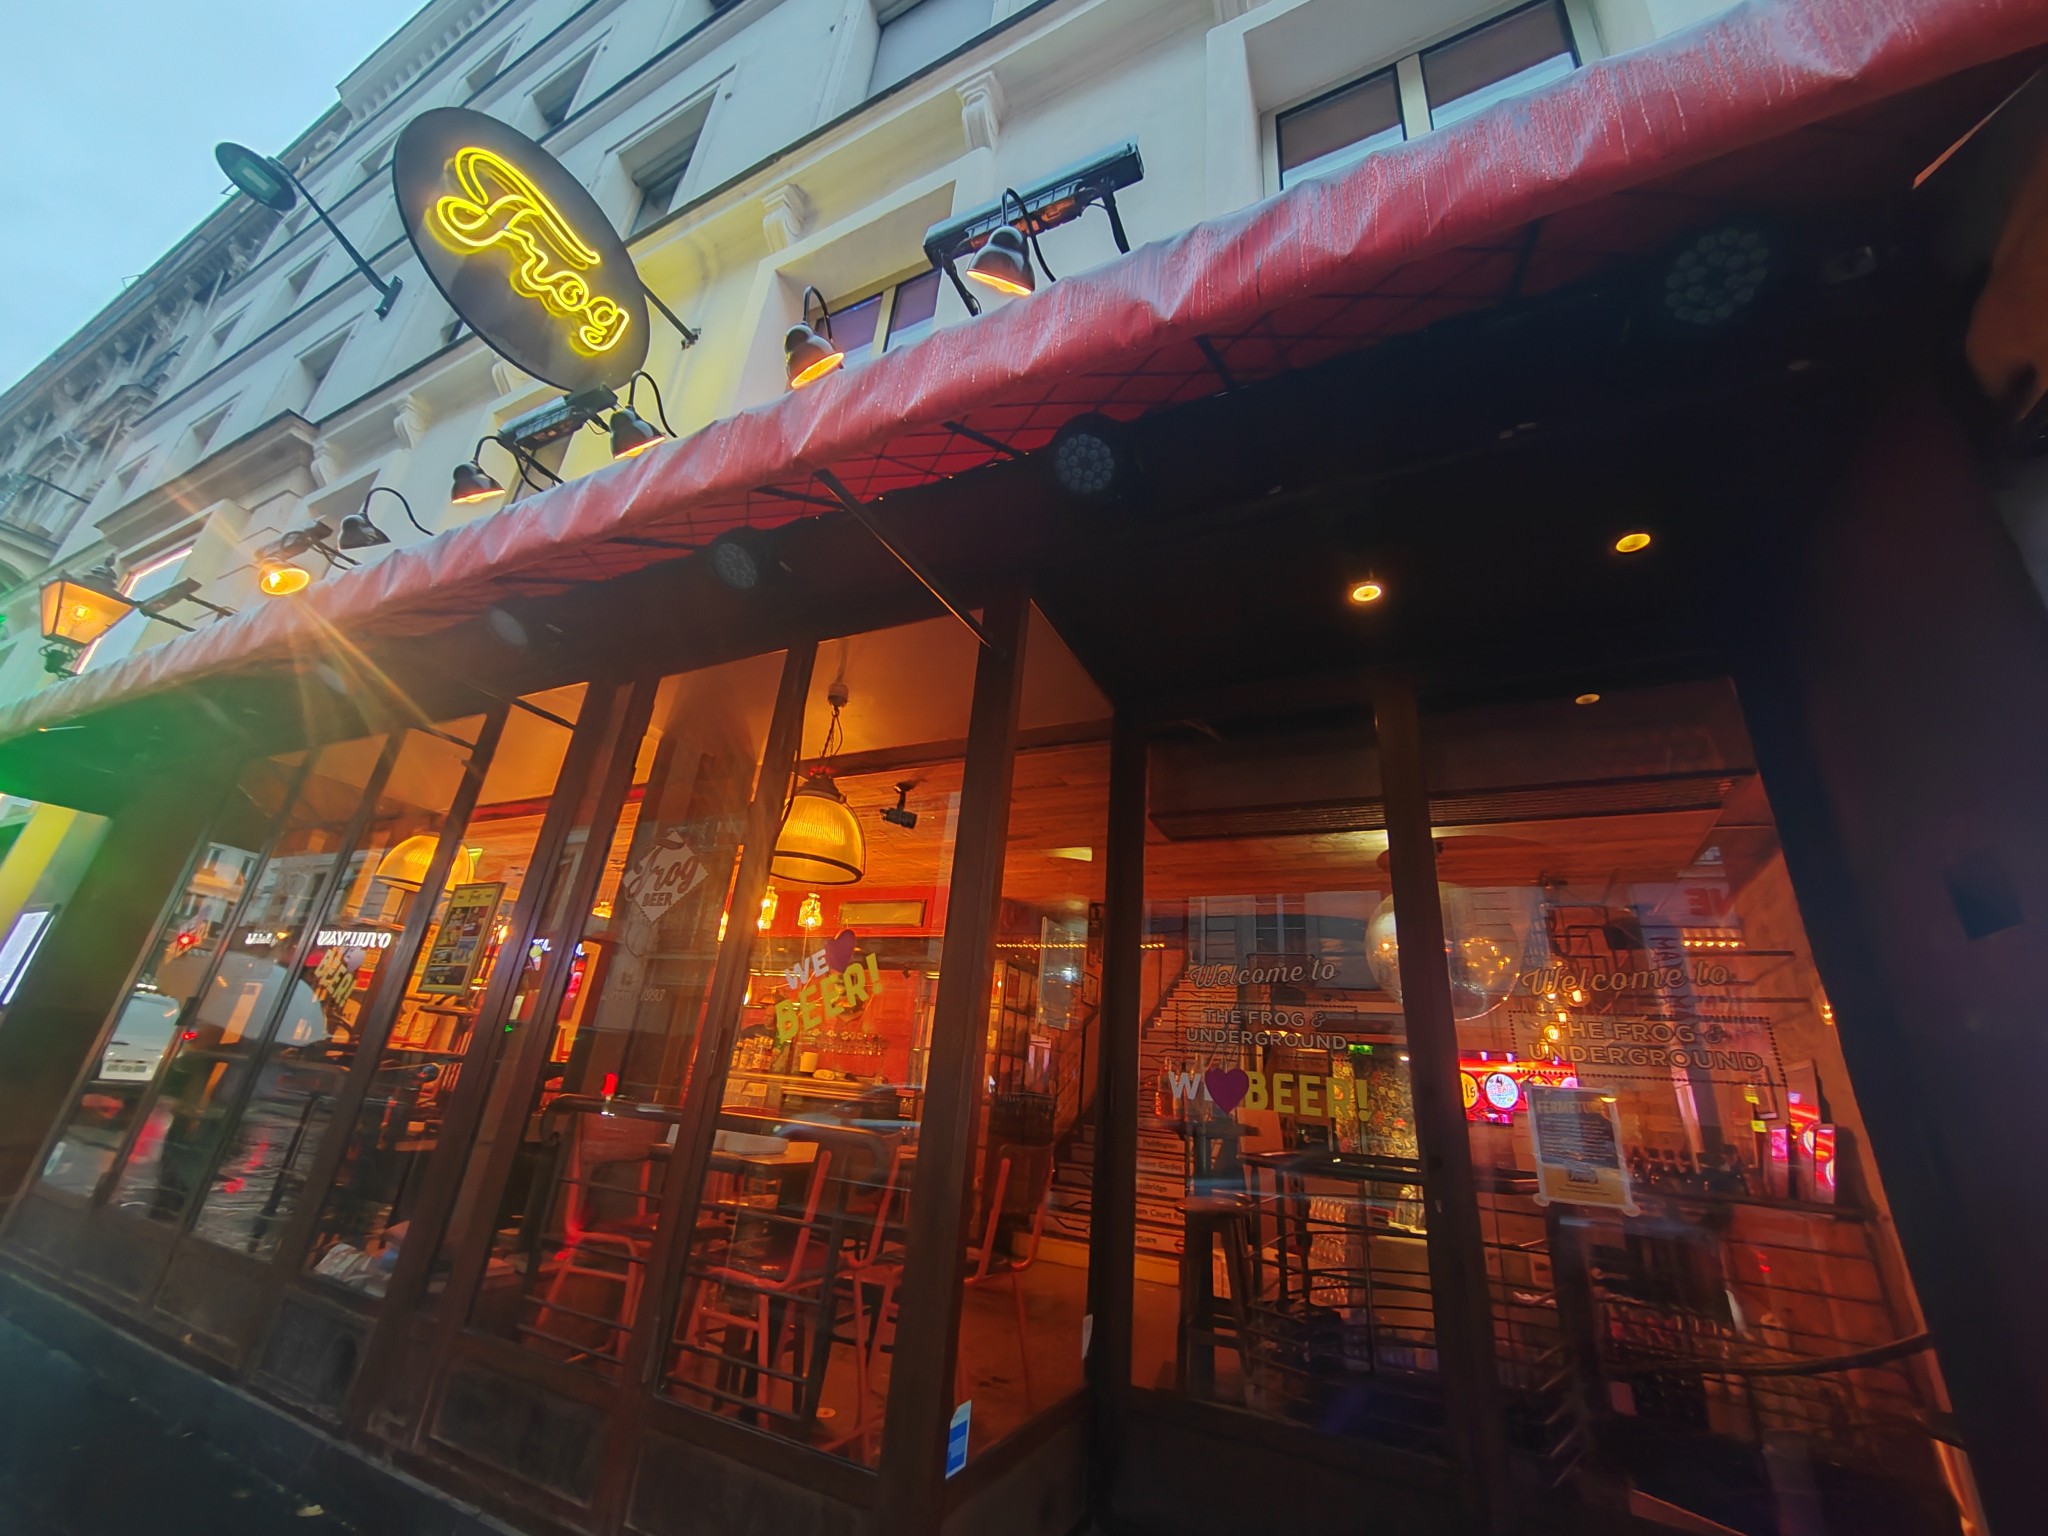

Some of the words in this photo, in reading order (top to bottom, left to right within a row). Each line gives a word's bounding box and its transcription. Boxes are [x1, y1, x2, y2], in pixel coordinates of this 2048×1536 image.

[627, 838, 701, 899] Frog
[641, 891, 673, 907] BEER
[783, 948, 830, 990] WE
[1189, 963, 1307, 989] Welcome
[1311, 959, 1338, 981] to
[1521, 965, 1688, 996] Welcome
[1694, 959, 1730, 987] to
[775, 952, 883, 1044] BEER!
[1203, 1008, 1242, 1024] THE
[1248, 1010, 1305, 1027] FROG
[1311, 1012, 1326, 1028] &
[1550, 1020, 1607, 1040] THE
[1614, 1022, 1696, 1043] FROG
[1705, 1023, 1730, 1044] &
[1186, 1028, 1347, 1050] UNDERGROUND
[1528, 1042, 1763, 1072] UNDERGROUND
[1168, 1071, 1216, 1102] W
[1244, 1070, 1374, 1122] BEER!
